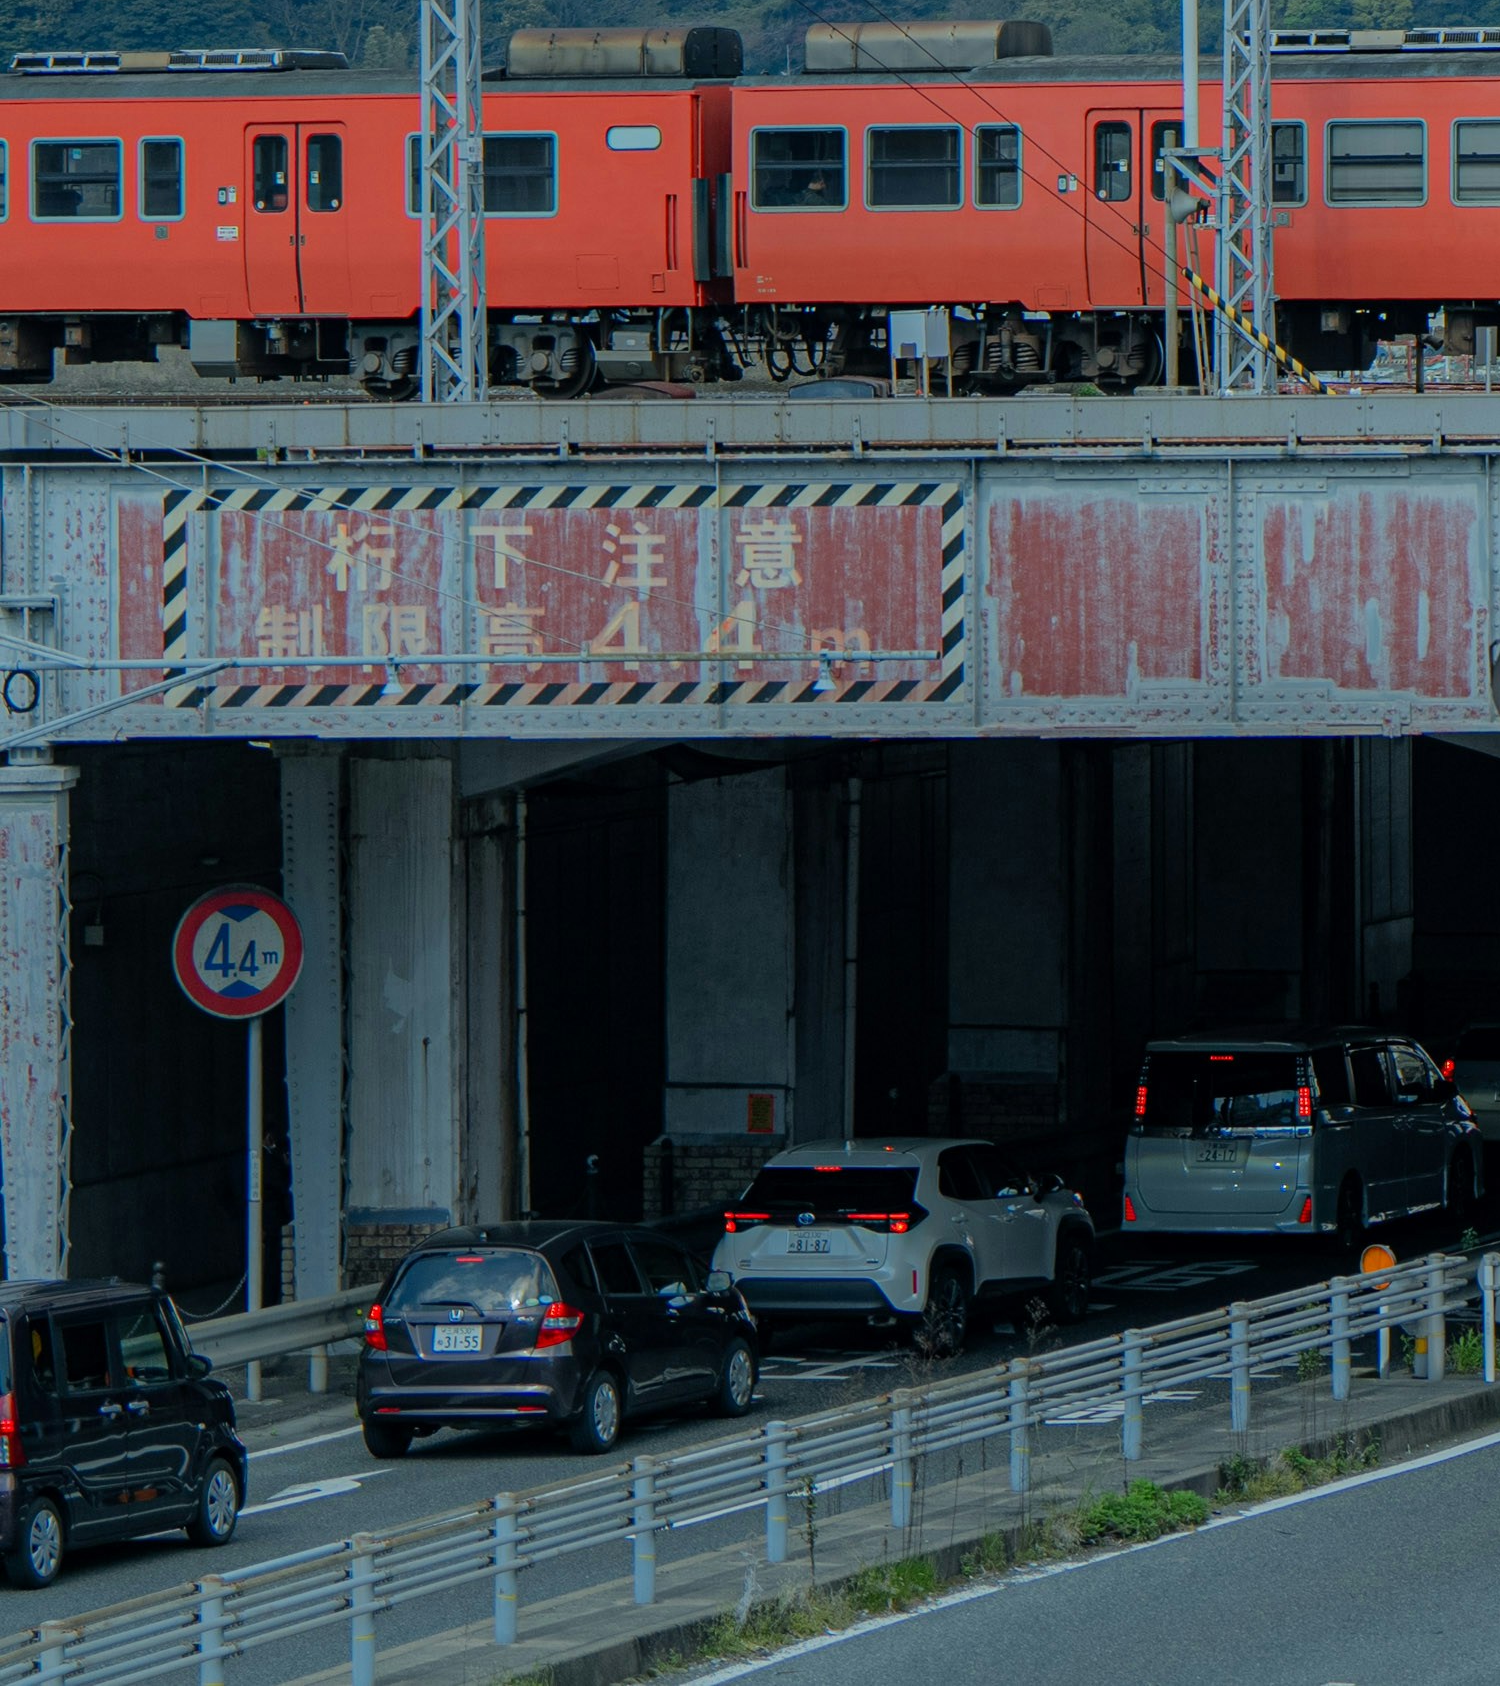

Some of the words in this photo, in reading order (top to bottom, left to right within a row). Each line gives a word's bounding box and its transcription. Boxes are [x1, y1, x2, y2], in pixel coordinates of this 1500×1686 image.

[326, 520, 803, 592] 桁下注意
[204, 922, 279, 978] 4.4m
[444, 1335, 479, 1349] 31-55
